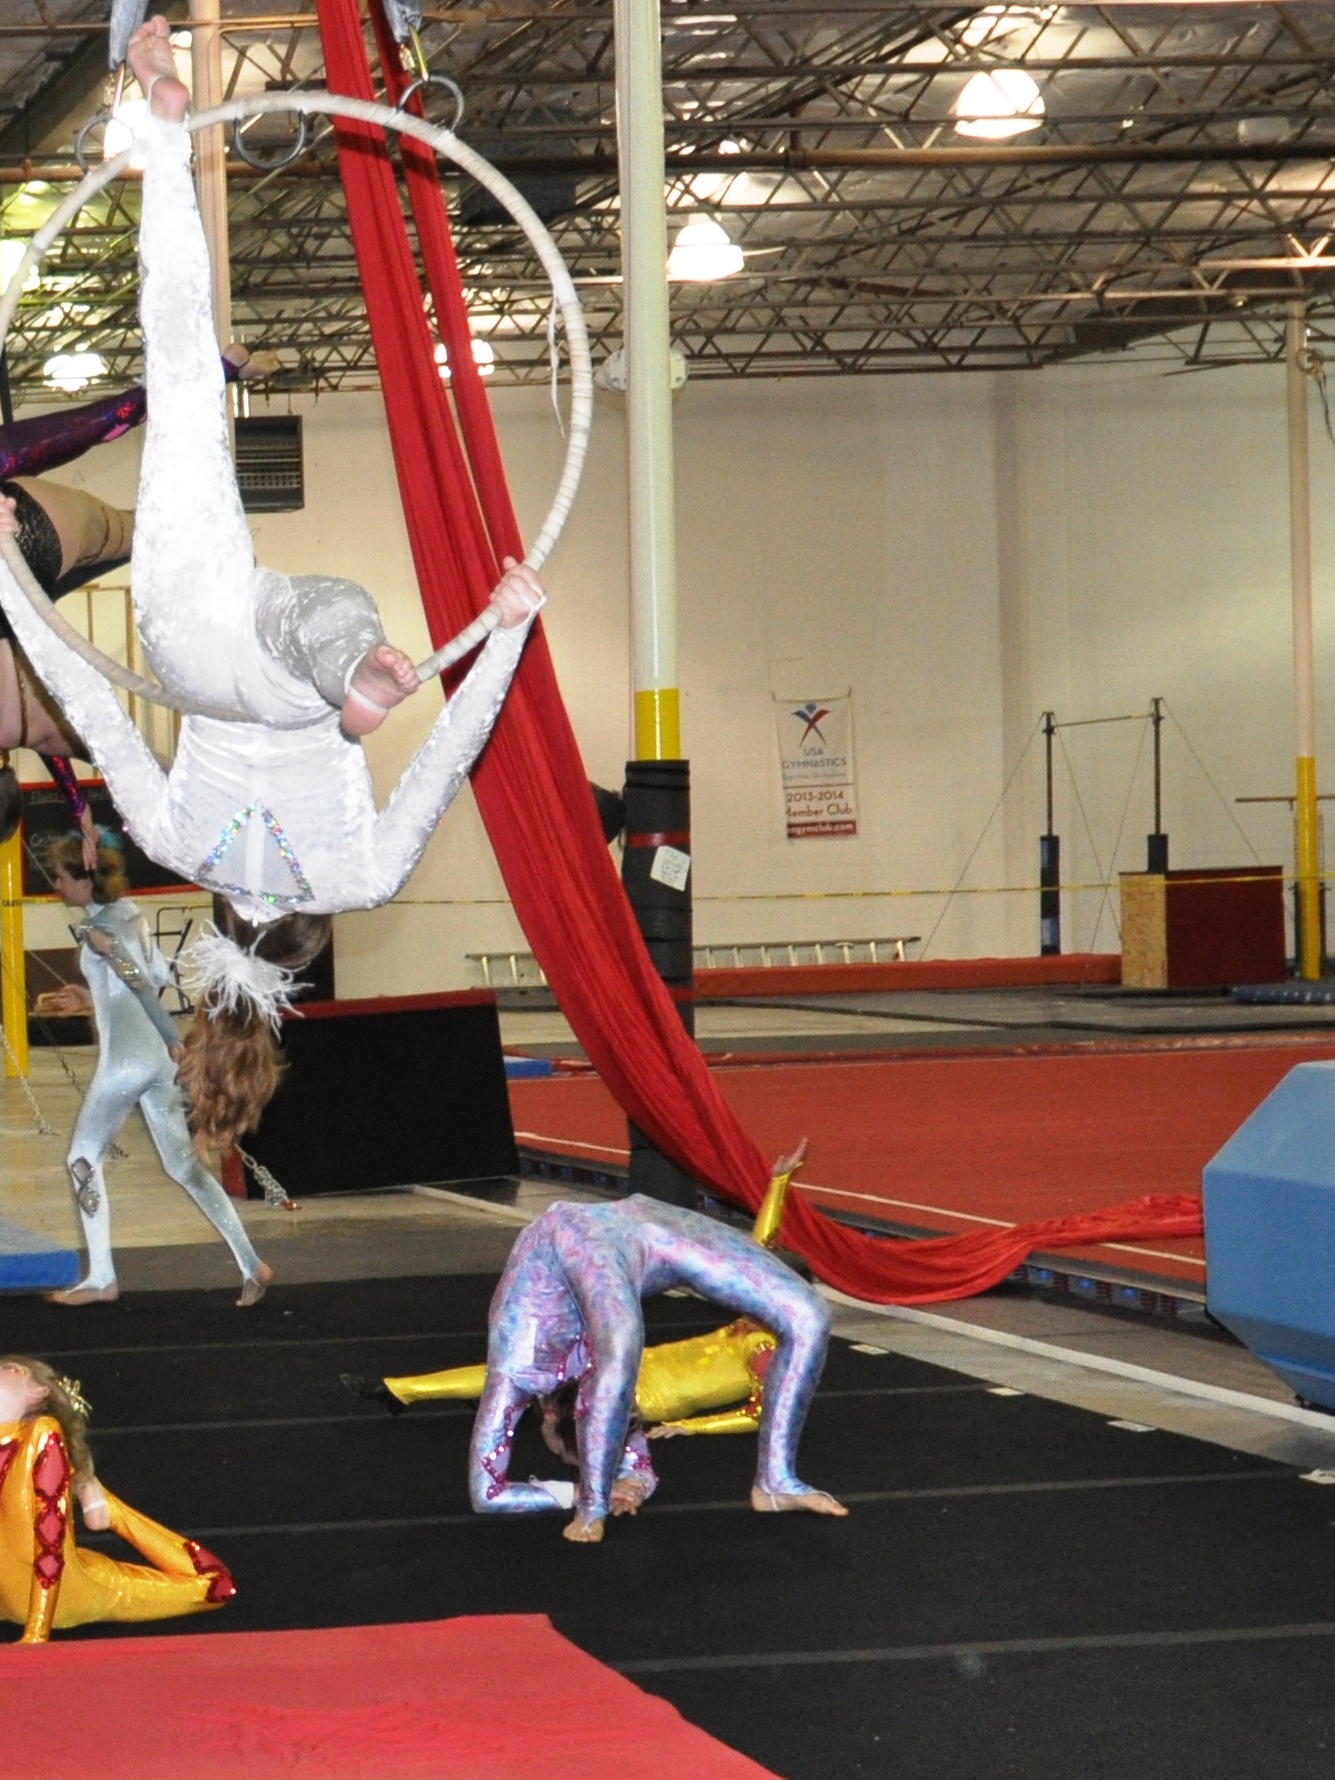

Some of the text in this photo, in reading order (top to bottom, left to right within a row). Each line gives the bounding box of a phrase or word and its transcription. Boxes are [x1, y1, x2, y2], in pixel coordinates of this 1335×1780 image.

[804, 747, 824, 756] USA
[782, 757, 847, 769] GYMNASTICS
[787, 790, 844, 802] 2013-2014
[827, 802, 853, 815] Club
